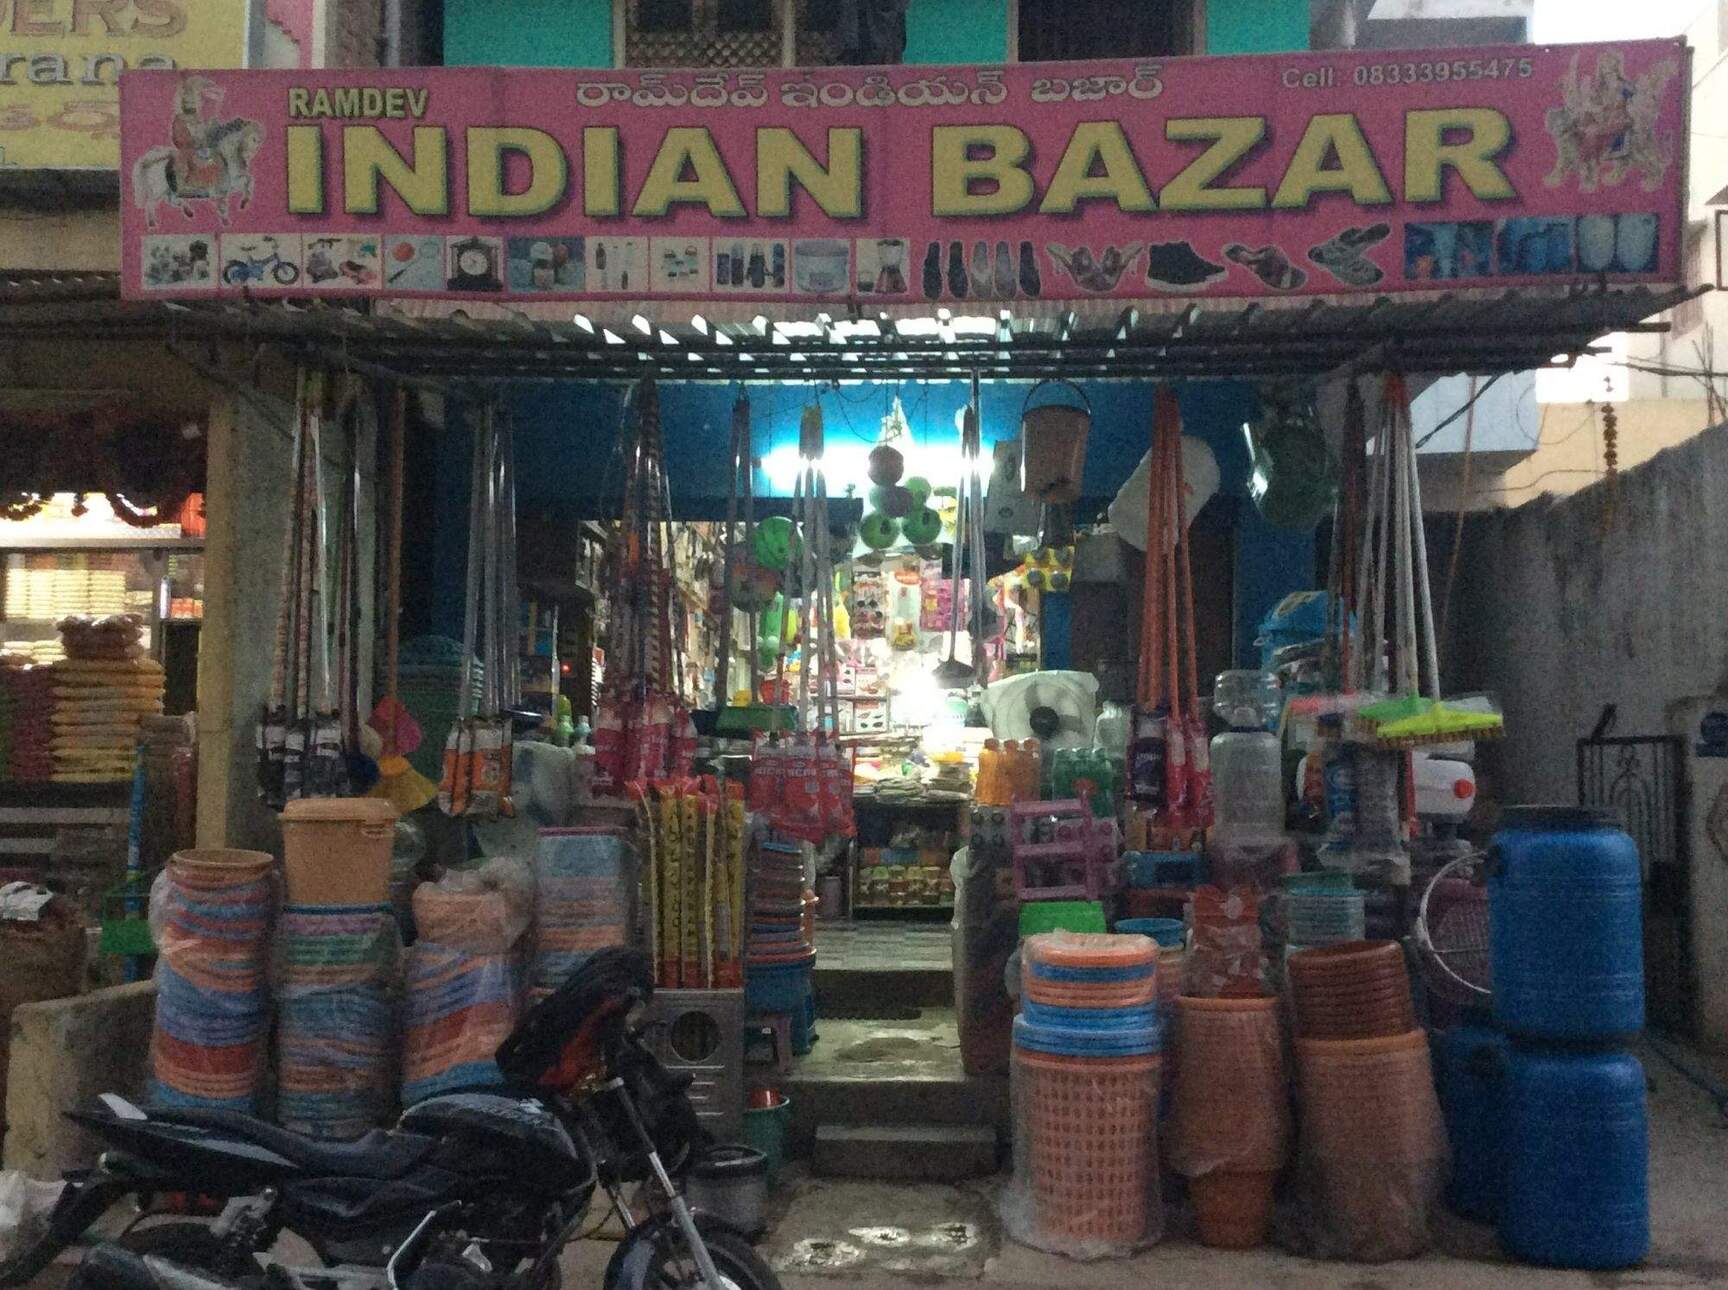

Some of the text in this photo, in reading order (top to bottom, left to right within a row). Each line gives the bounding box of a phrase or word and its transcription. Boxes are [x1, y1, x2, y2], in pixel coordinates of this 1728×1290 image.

[0, 0, 188, 38] ERS
[1031, 65, 1165, 102] బజార్
[1353, 58, 1533, 86] 08333955475
[288, 87, 429, 118] RAMDEV
[286, 106, 1519, 218] INDIAN BAZAR
